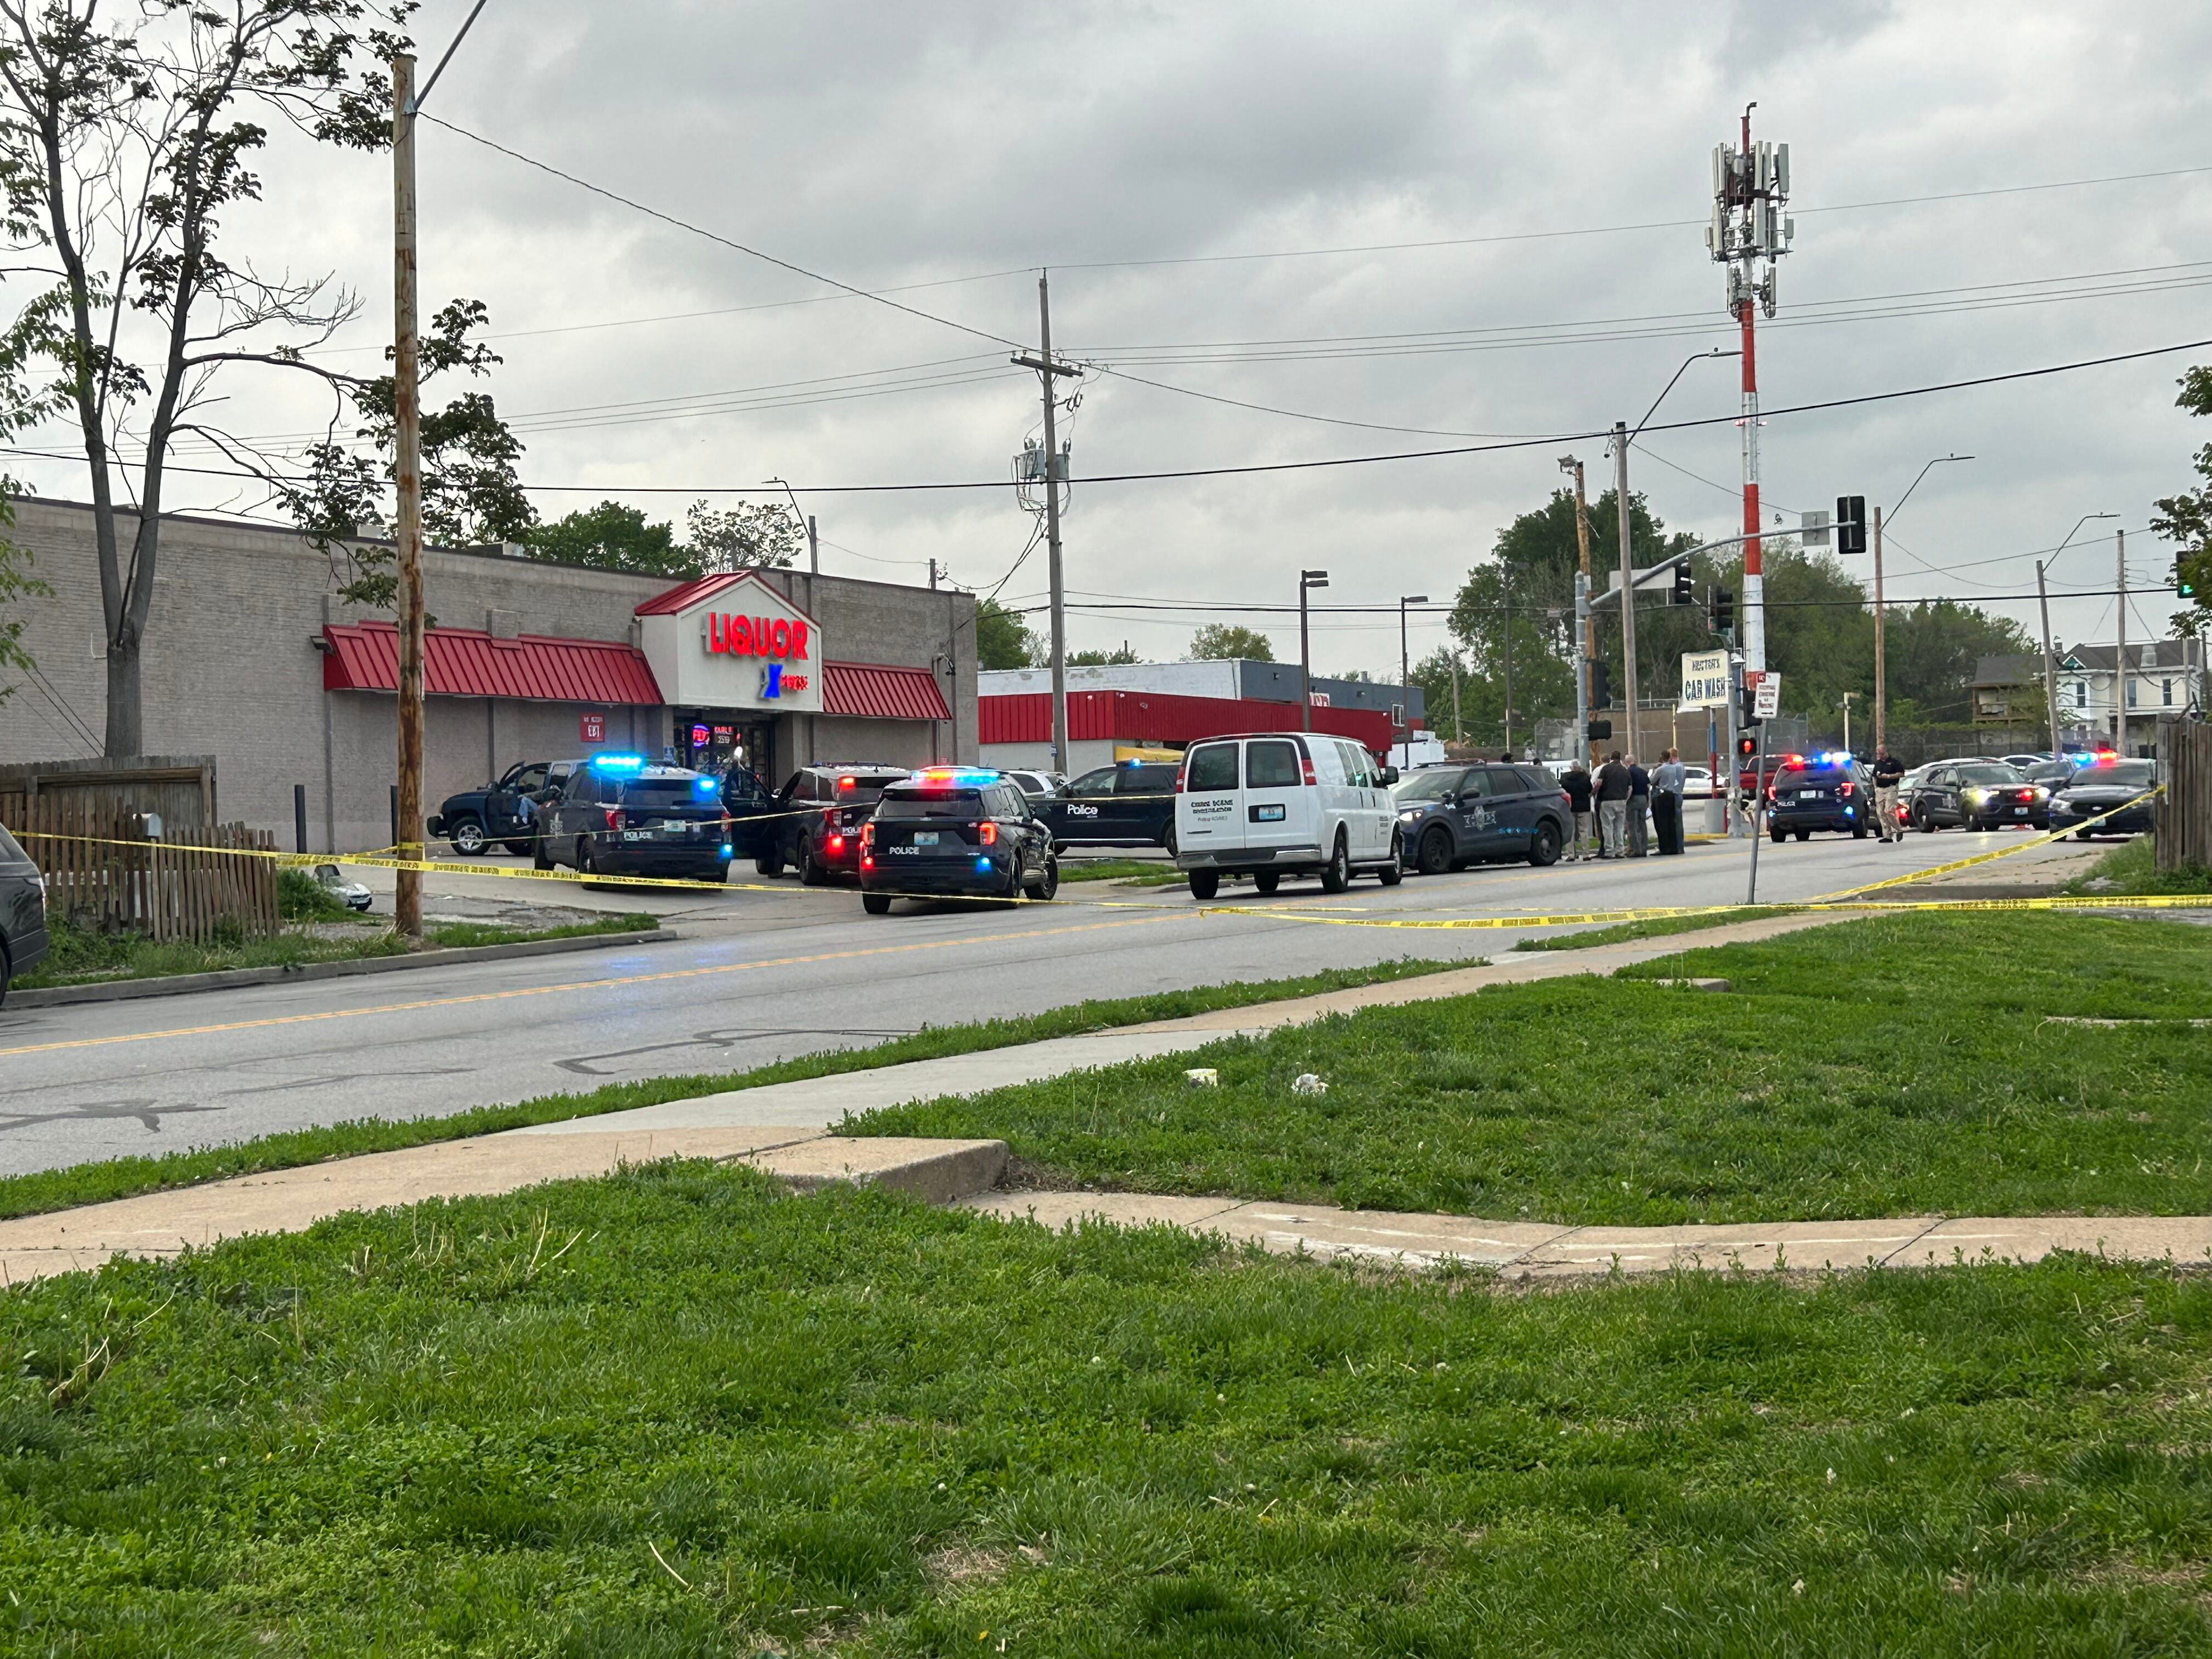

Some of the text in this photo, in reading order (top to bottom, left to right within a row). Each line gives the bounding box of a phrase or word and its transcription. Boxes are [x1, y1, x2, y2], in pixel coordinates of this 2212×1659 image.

[709, 611, 808, 660] LIQUOR
[1685, 677, 1726, 701] CAR WASH
[1067, 804, 1098, 815] Police
